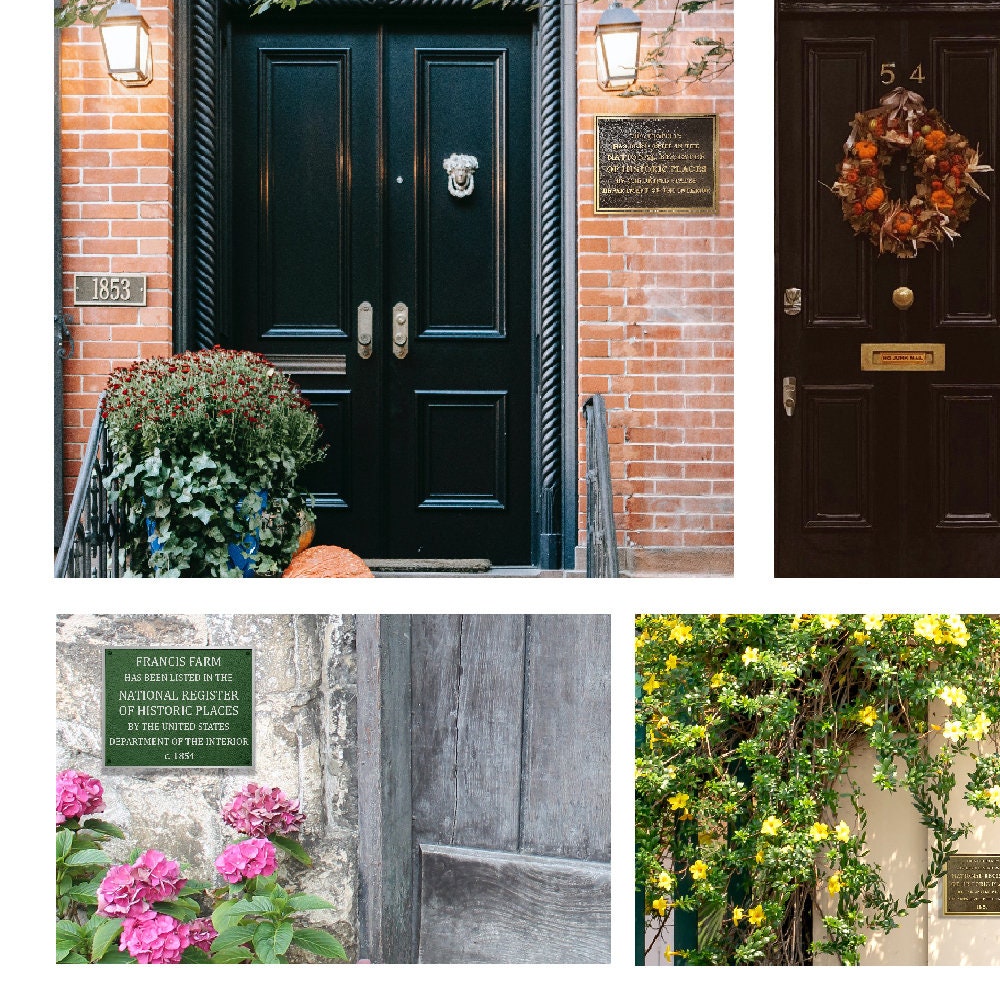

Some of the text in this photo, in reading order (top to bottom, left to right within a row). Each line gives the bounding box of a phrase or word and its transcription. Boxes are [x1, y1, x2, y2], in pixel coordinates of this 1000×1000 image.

[92, 278, 130, 300] 1853
[136, 657, 221, 666] FRANCIS FARM
[119, 690, 239, 700] NATIONAL REGISTER
[119, 706, 239, 716] OF HISTORIC PLACES
[128, 723, 230, 731] BY THE UNITED STATES
[109, 738, 249, 746] DEPARTMENT OF THE INTERIOR
